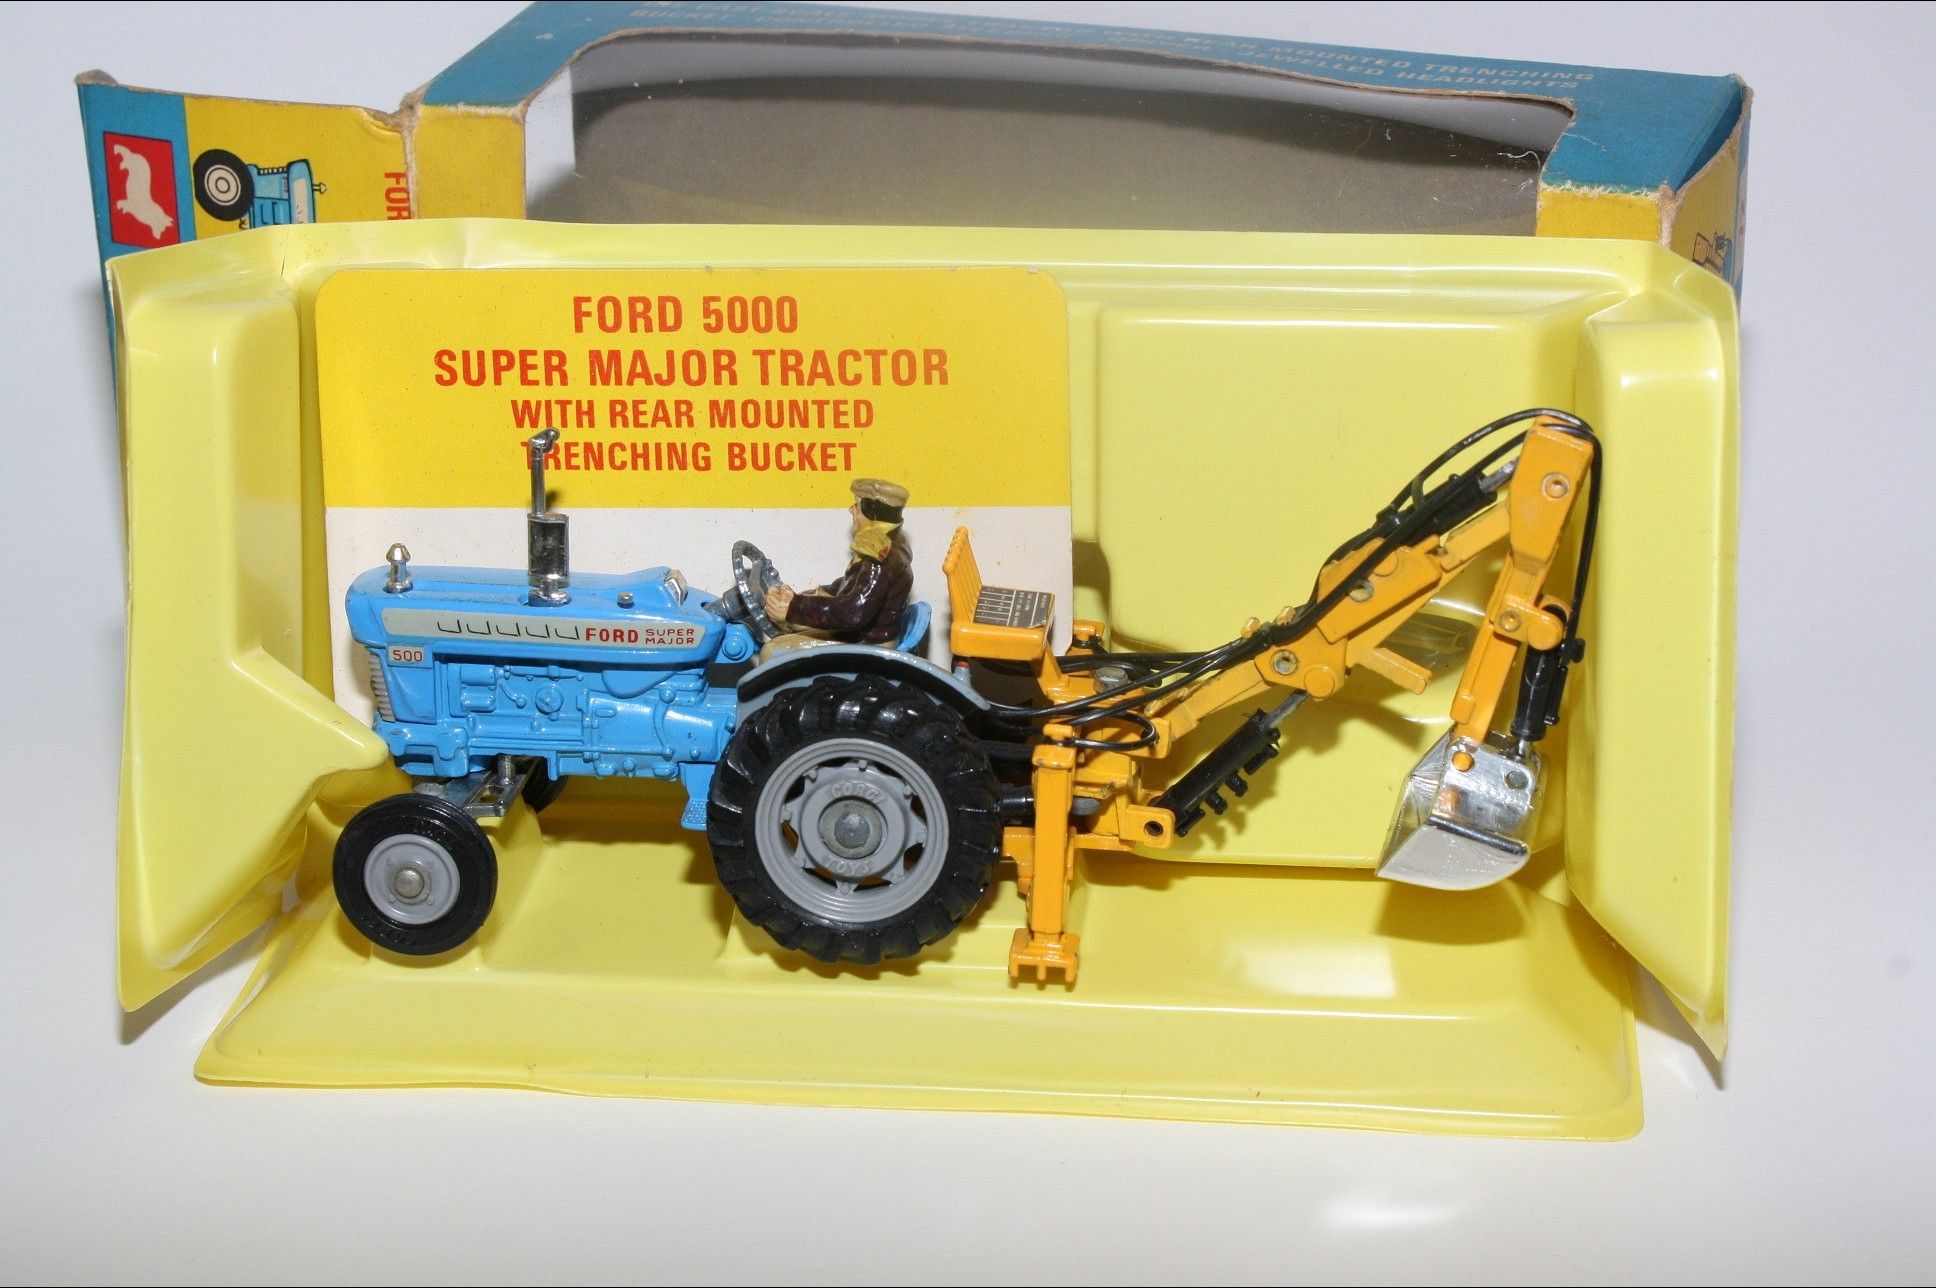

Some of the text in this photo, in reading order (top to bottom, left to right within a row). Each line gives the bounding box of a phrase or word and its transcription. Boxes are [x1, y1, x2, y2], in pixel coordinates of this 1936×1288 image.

[1236, 51, 1579, 89] JEWELLED HEADLIGHTS
[1269, 46, 1411, 68] MOUNTED
[1424, 63, 1595, 80] TRENCHING
[573, 295, 798, 334] FORD 5000
[434, 349, 948, 387] SUPER MAJOR TRACTOR
[511, 399, 874, 429] WITH REAR MOUNTED
[727, 442, 857, 472] BUCKET
[585, 627, 639, 643] FORD
[645, 628, 695, 636] SUPER
[645, 637, 695, 645] MAJOR
[392, 649, 423, 662] 500
[831, 781, 886, 805] CORGI
[828, 855, 871, 874] TOYS
